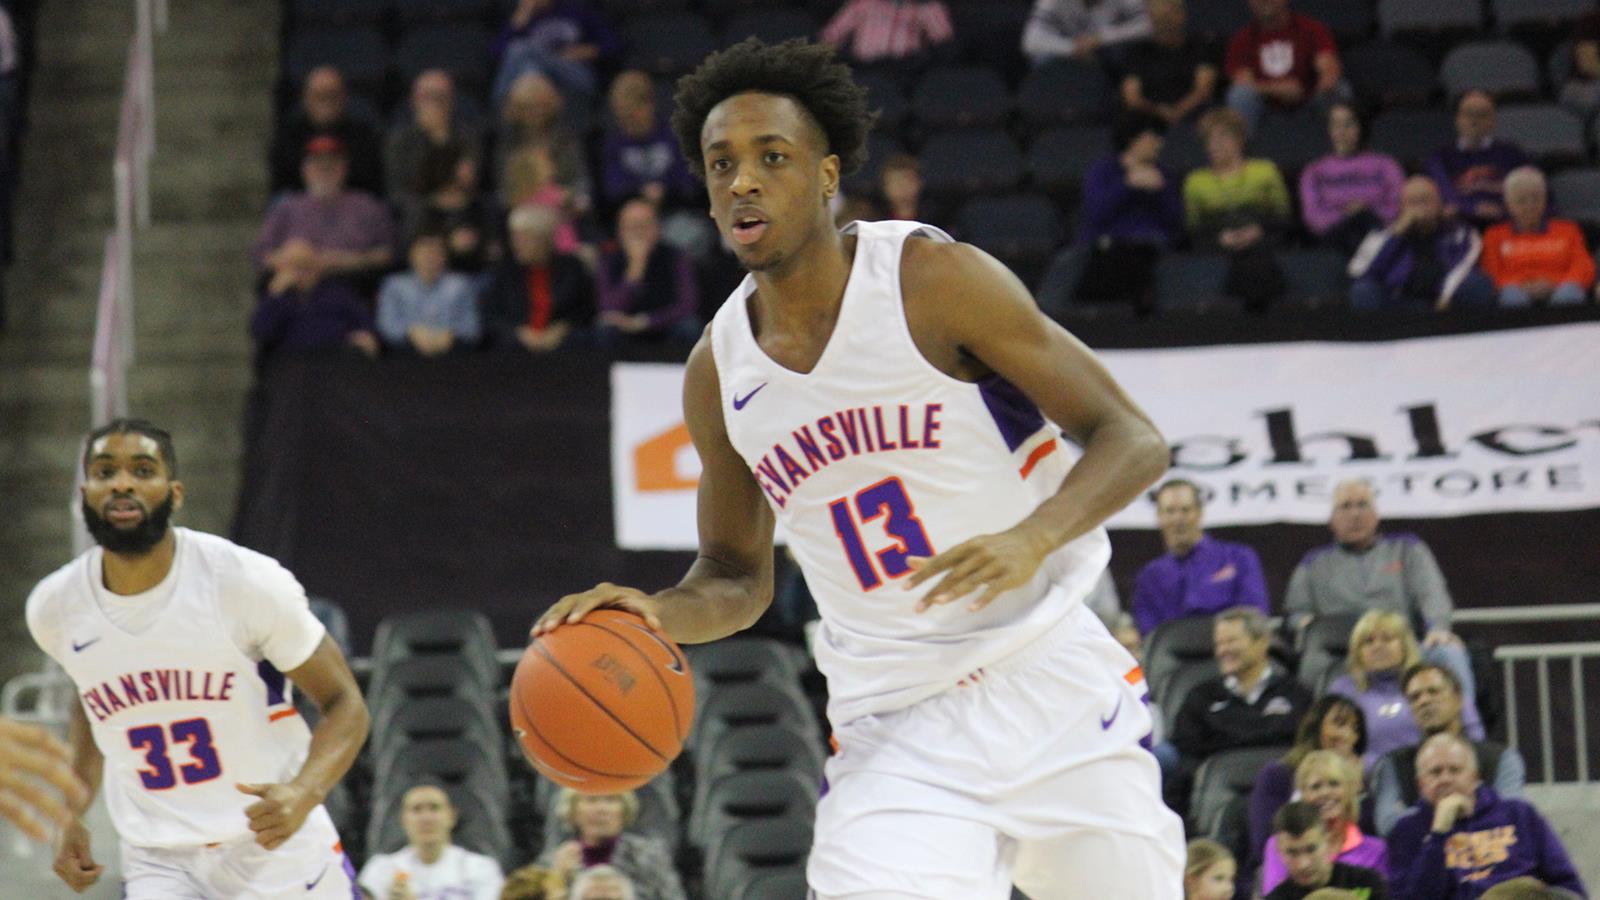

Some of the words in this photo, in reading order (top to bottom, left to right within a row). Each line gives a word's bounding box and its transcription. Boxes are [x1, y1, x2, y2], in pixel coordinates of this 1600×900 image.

[754, 403, 943, 510] EVANSVILLE
[828, 475, 937, 593] 13
[83, 669, 236, 722] EVANSVILLE
[127, 717, 222, 791] 33
